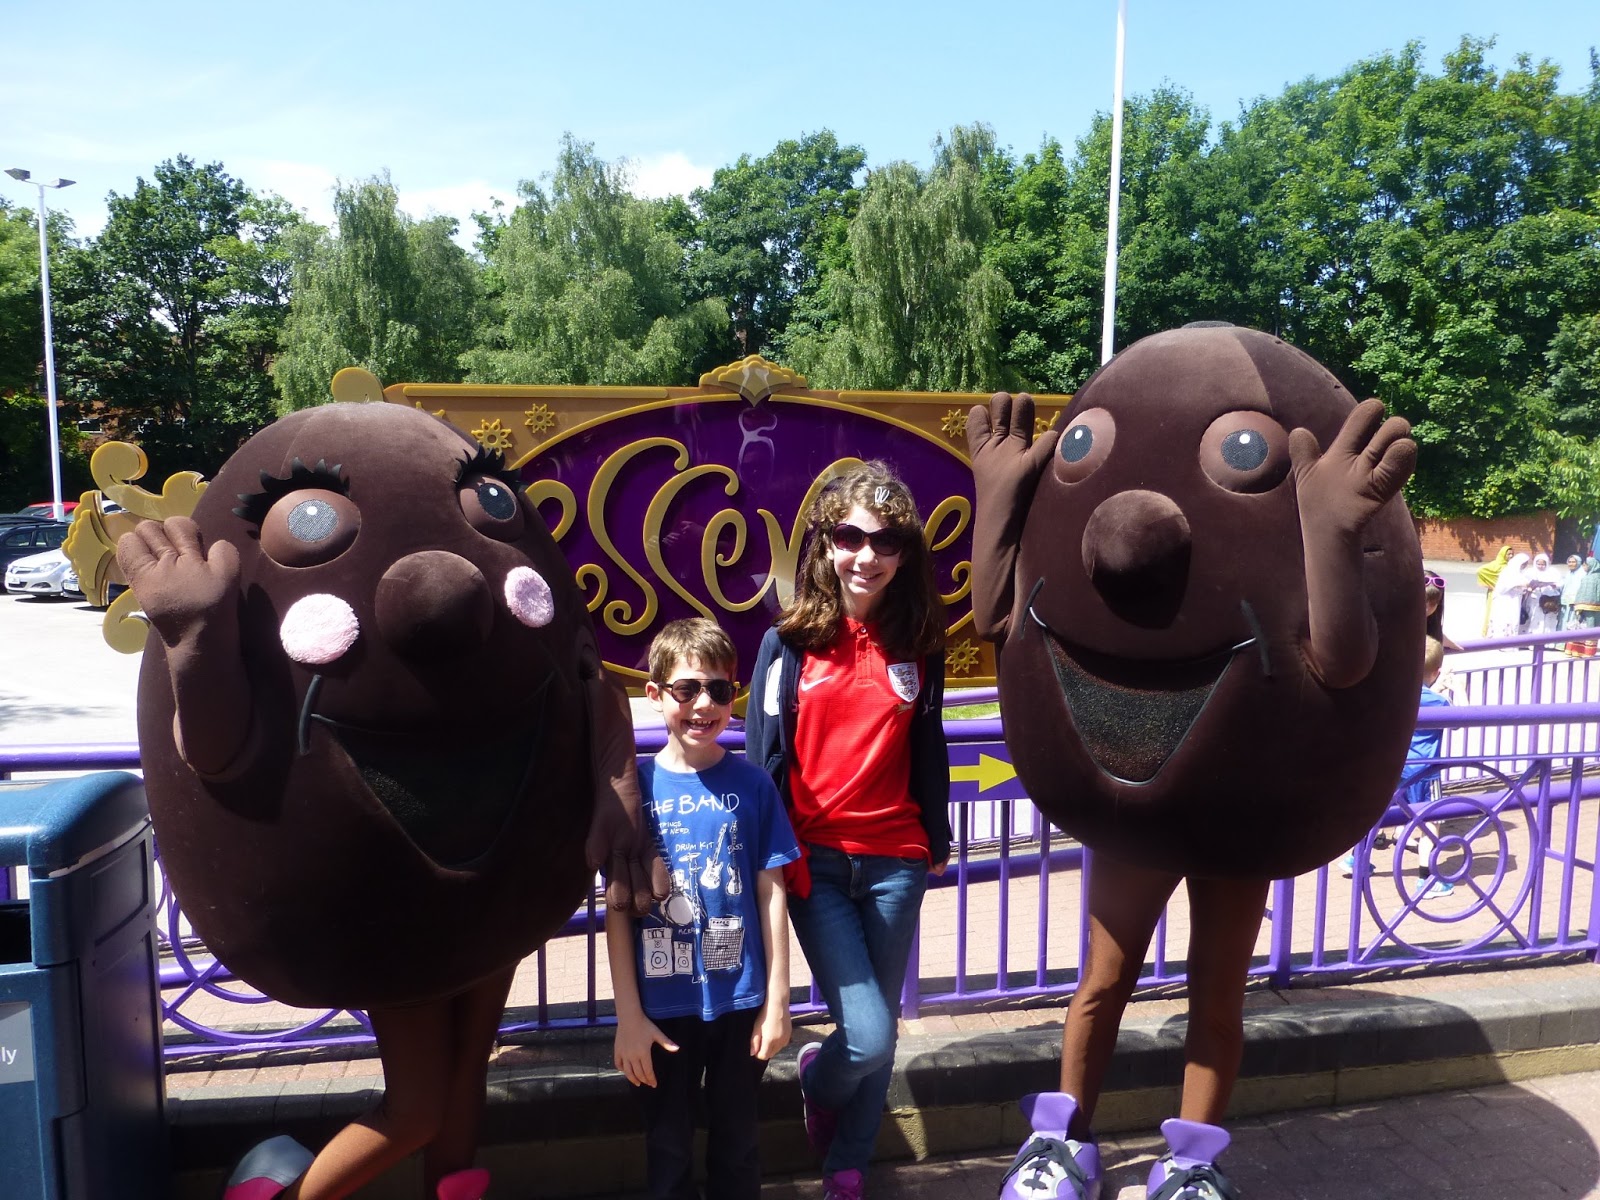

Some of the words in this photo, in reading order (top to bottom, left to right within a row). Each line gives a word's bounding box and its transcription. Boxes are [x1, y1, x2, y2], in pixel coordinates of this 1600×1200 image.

[677, 792, 740, 815] BAND
[675, 842, 697, 853] DRUM
[699, 841, 715, 851] KIT
